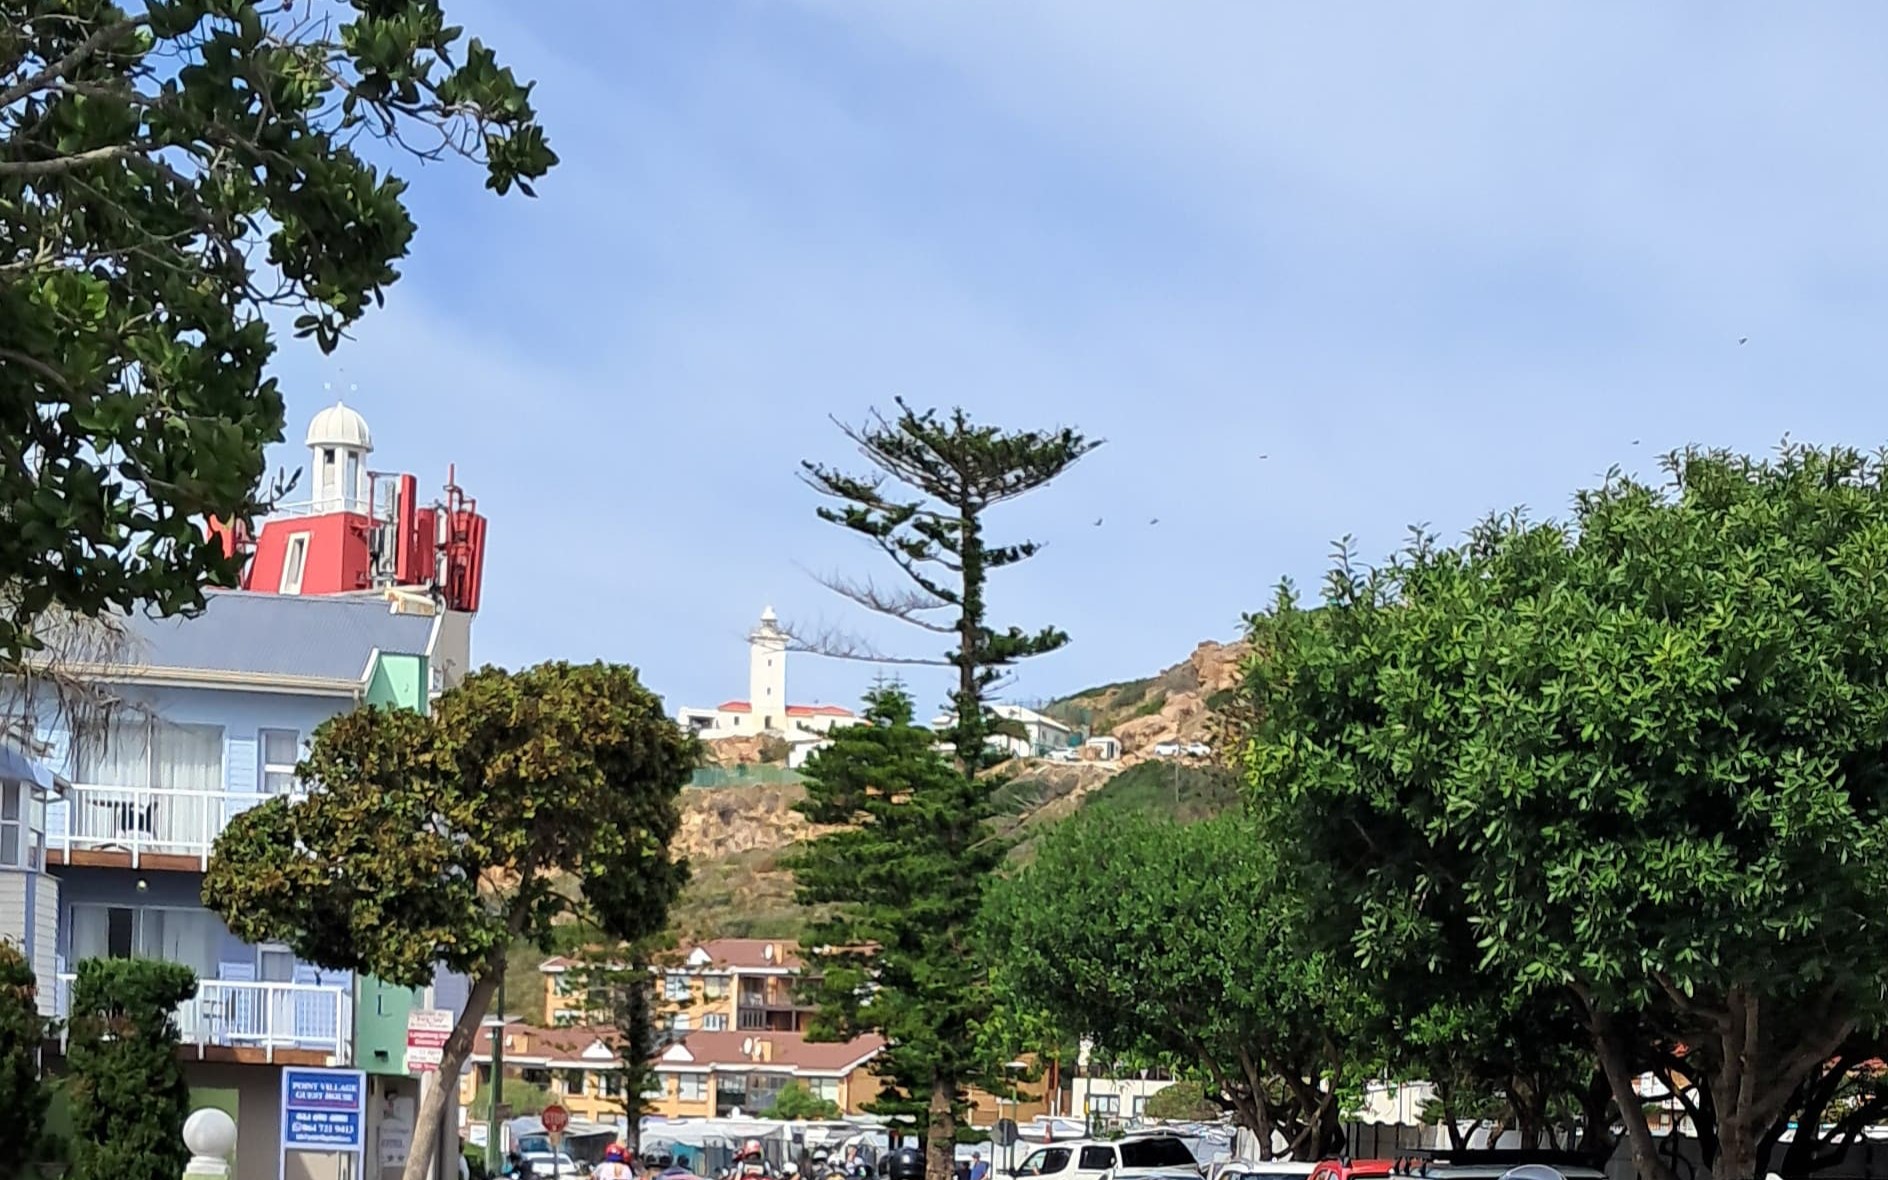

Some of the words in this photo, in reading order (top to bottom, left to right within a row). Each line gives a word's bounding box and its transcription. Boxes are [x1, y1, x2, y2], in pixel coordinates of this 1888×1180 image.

[292, 1082, 319, 1091] POINT
[320, 1083, 357, 1093] VILLAGE
[295, 1091, 323, 1100] GUEST
[324, 1092, 354, 1102] HOUSE
[544, 1113, 568, 1125] STOP
